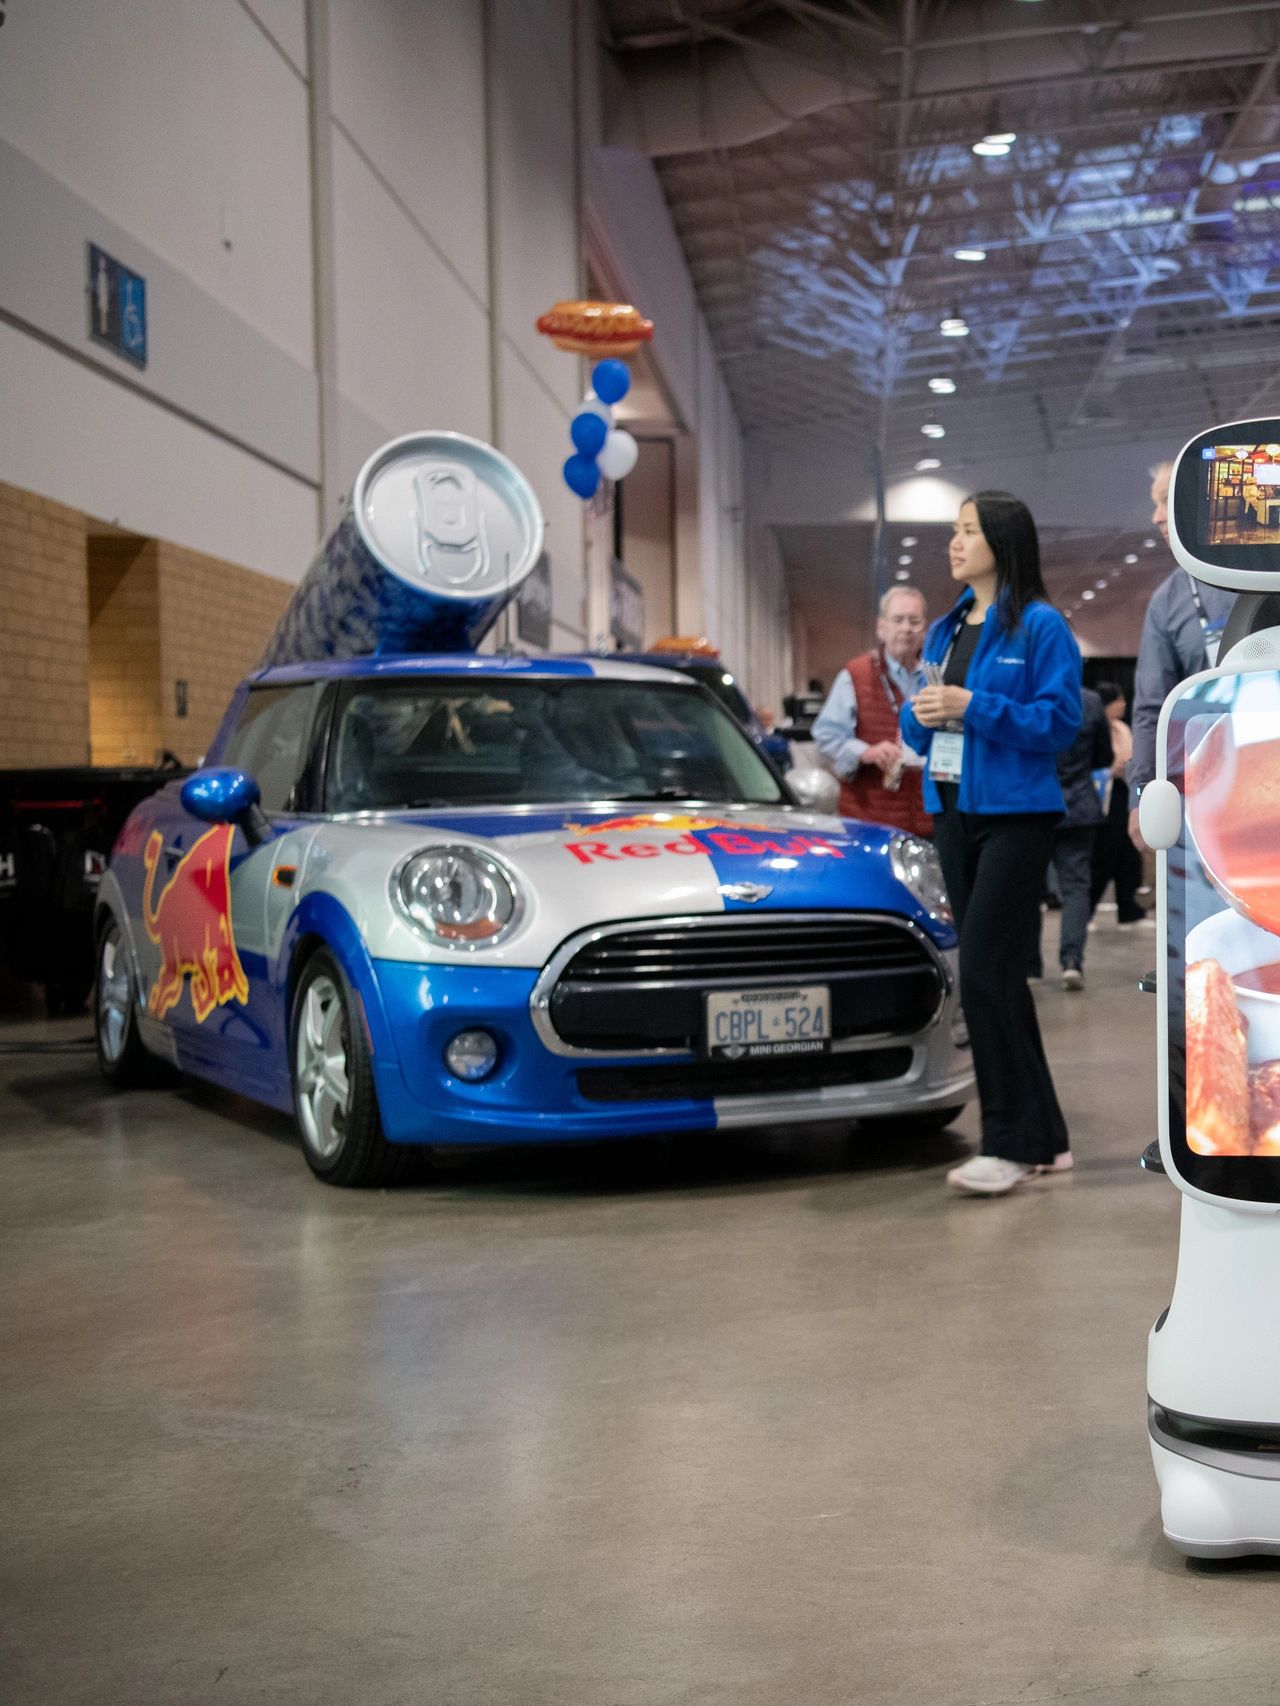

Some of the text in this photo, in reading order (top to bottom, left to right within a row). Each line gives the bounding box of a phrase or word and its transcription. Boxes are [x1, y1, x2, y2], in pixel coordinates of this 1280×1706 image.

[564, 833, 845, 864] Red Bull
[715, 1006, 823, 1040] CBPL 524
[749, 1041, 824, 1056] MINI GEORGIAN
